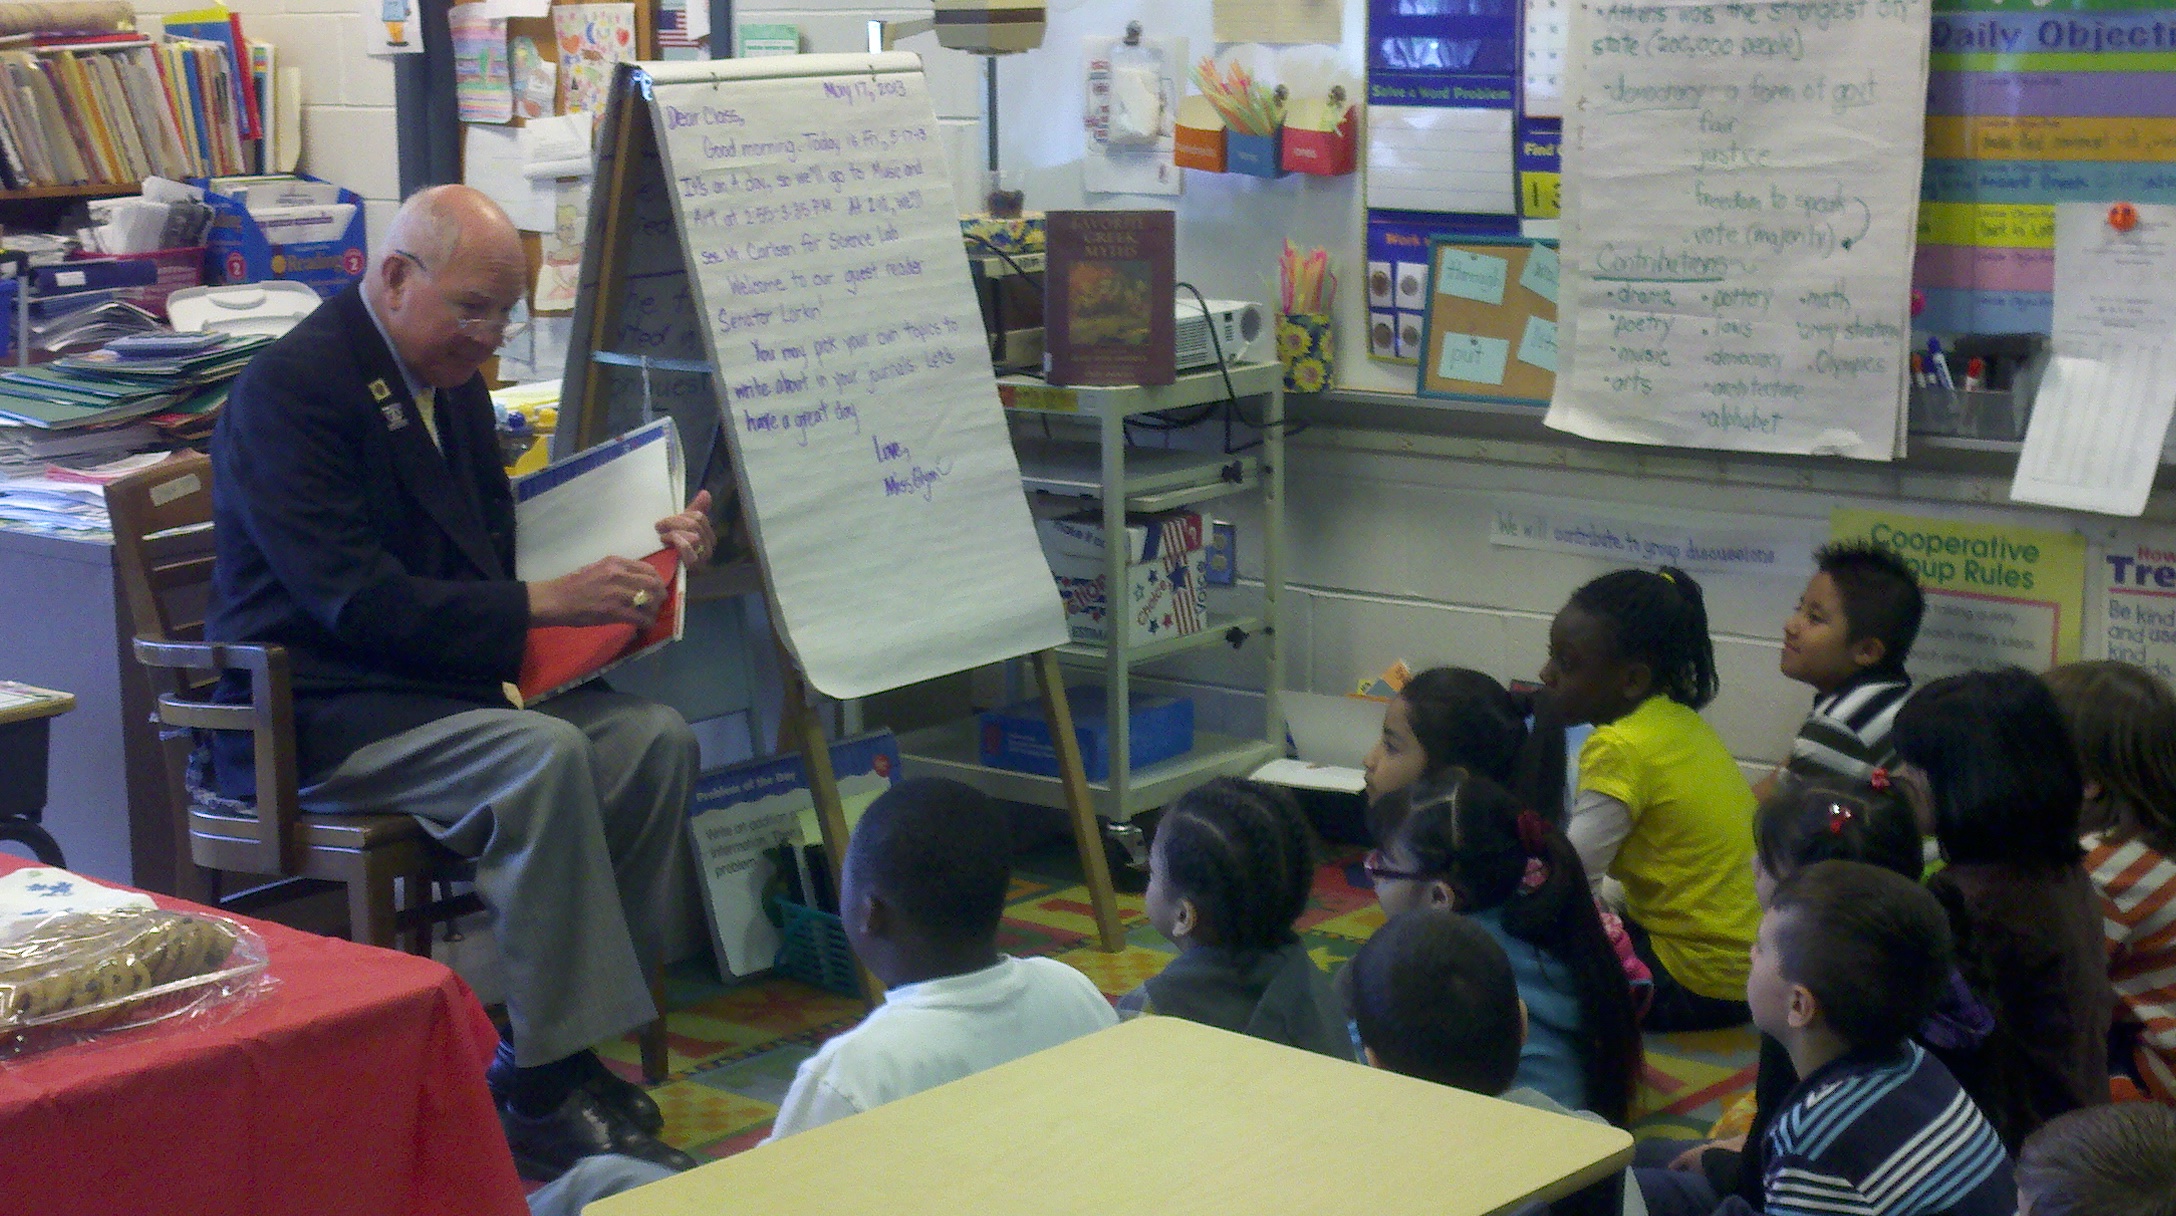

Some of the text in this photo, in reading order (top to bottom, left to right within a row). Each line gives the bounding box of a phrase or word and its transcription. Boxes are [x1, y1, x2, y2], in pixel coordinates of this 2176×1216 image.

[1931, 18, 2021, 52] Daily
[1371, 84, 1406, 98] Solve
[1418, 87, 1450, 99] Word
[1453, 87, 1511, 99] Problem
[666, 105, 700, 130] Dear
[703, 135, 736, 159] Good
[1524, 142, 1554, 156] Find
[828, 170, 845, 193] go
[848, 161, 865, 180] to
[1770, 182, 1788, 209] to
[1386, 233, 1420, 246] Work
[1694, 221, 1739, 245] vote
[233, 262, 241, 276] 2
[287, 253, 343, 273] Reading
[350, 257, 358, 271] 2
[791, 270, 807, 288] to
[942, 316, 959, 333] to
[1451, 343, 1484, 370] put
[775, 370, 808, 395] about
[1611, 368, 1653, 397] arts
[744, 409, 779, 432] have
[782, 415, 791, 431] a
[795, 400, 828, 447] great
[1497, 510, 1517, 536] We
[1523, 515, 1548, 538] will
[1553, 521, 1624, 550] contribute
[1625, 530, 1640, 551] to
[1643, 540, 1681, 566] group
[1871, 523, 2041, 563] Cooperative
[1964, 560, 2034, 590] Rules
[2109, 602, 2174, 627] Be kind
[2108, 625, 2145, 644] and
[2108, 641, 2146, 663] kind
[696, 771, 796, 802] Problem of the Day
